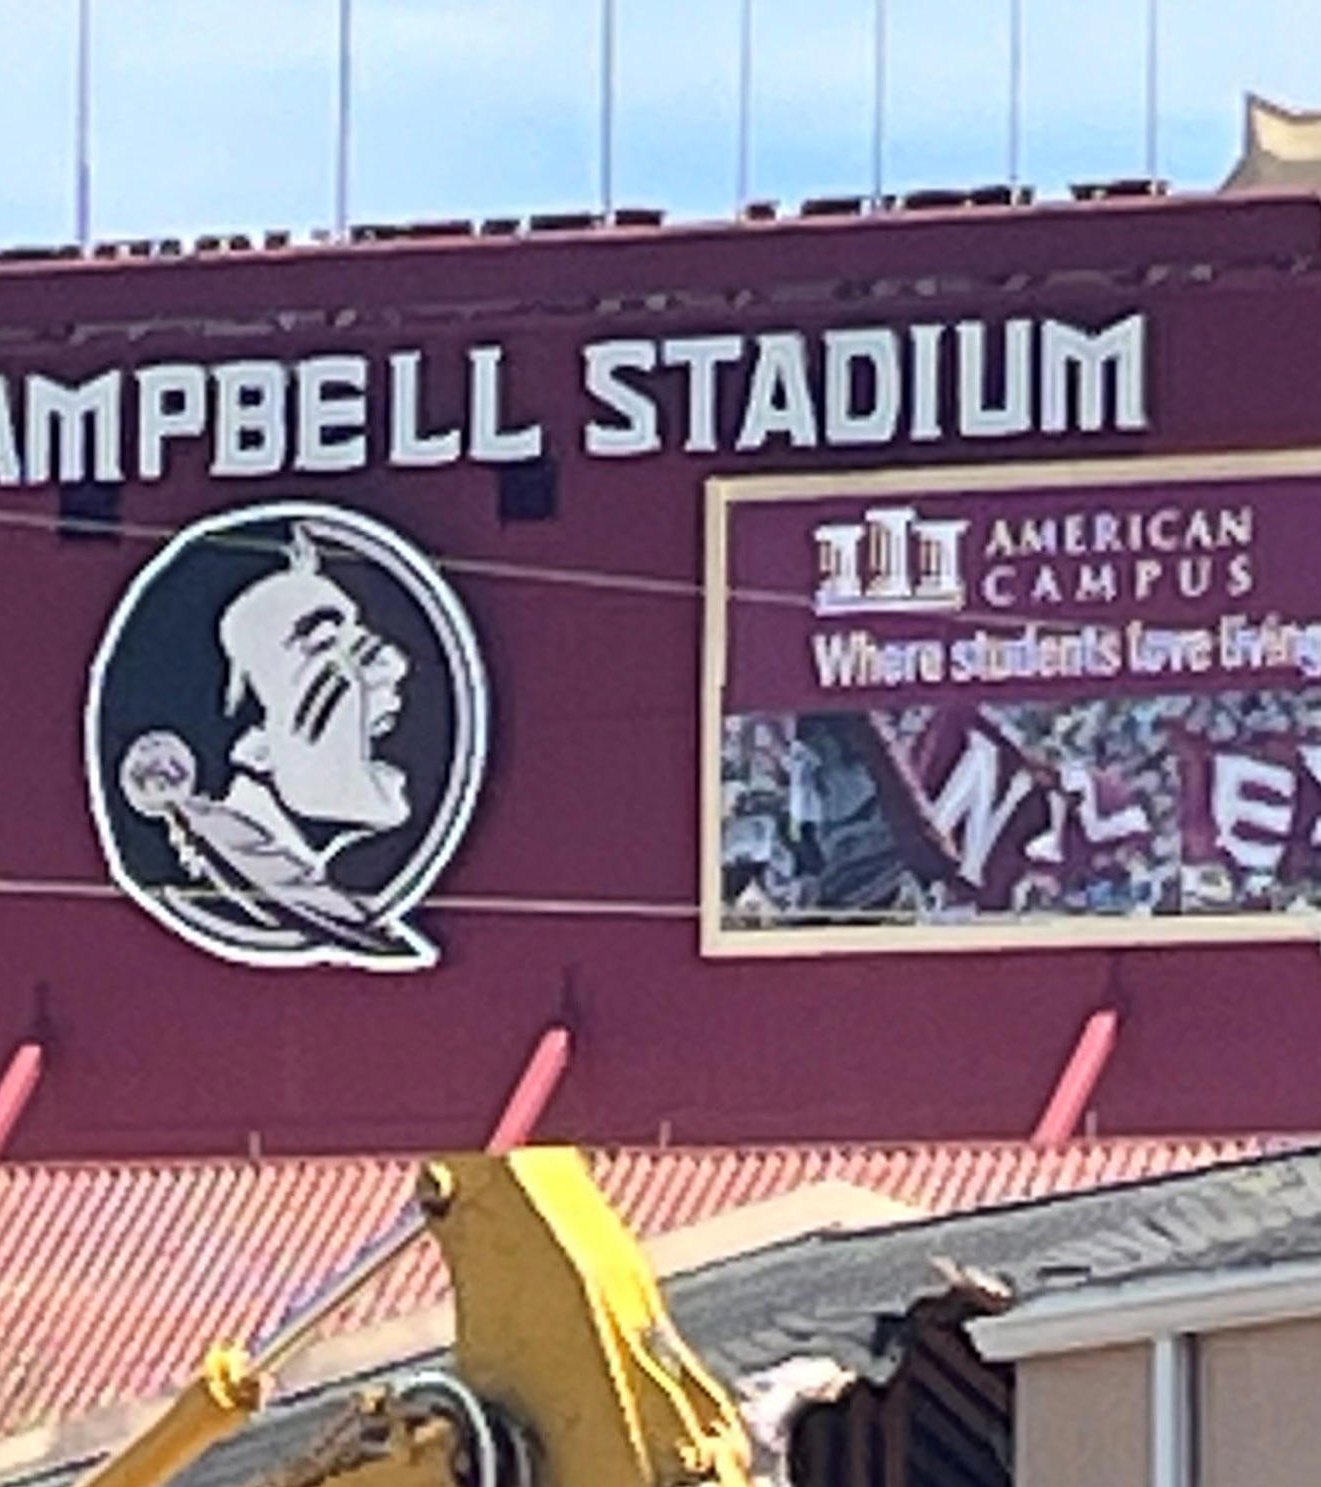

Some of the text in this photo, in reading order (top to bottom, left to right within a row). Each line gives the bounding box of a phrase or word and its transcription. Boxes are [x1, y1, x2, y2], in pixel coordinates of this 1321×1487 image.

[583, 313, 1148, 457] STADIUM
[984, 506, 1254, 558] AMERICAN
[982, 553, 1253, 606] CAMPUS
[812, 629, 944, 688] Where
[950, 616, 1122, 683] students
[1125, 618, 1213, 673] love
